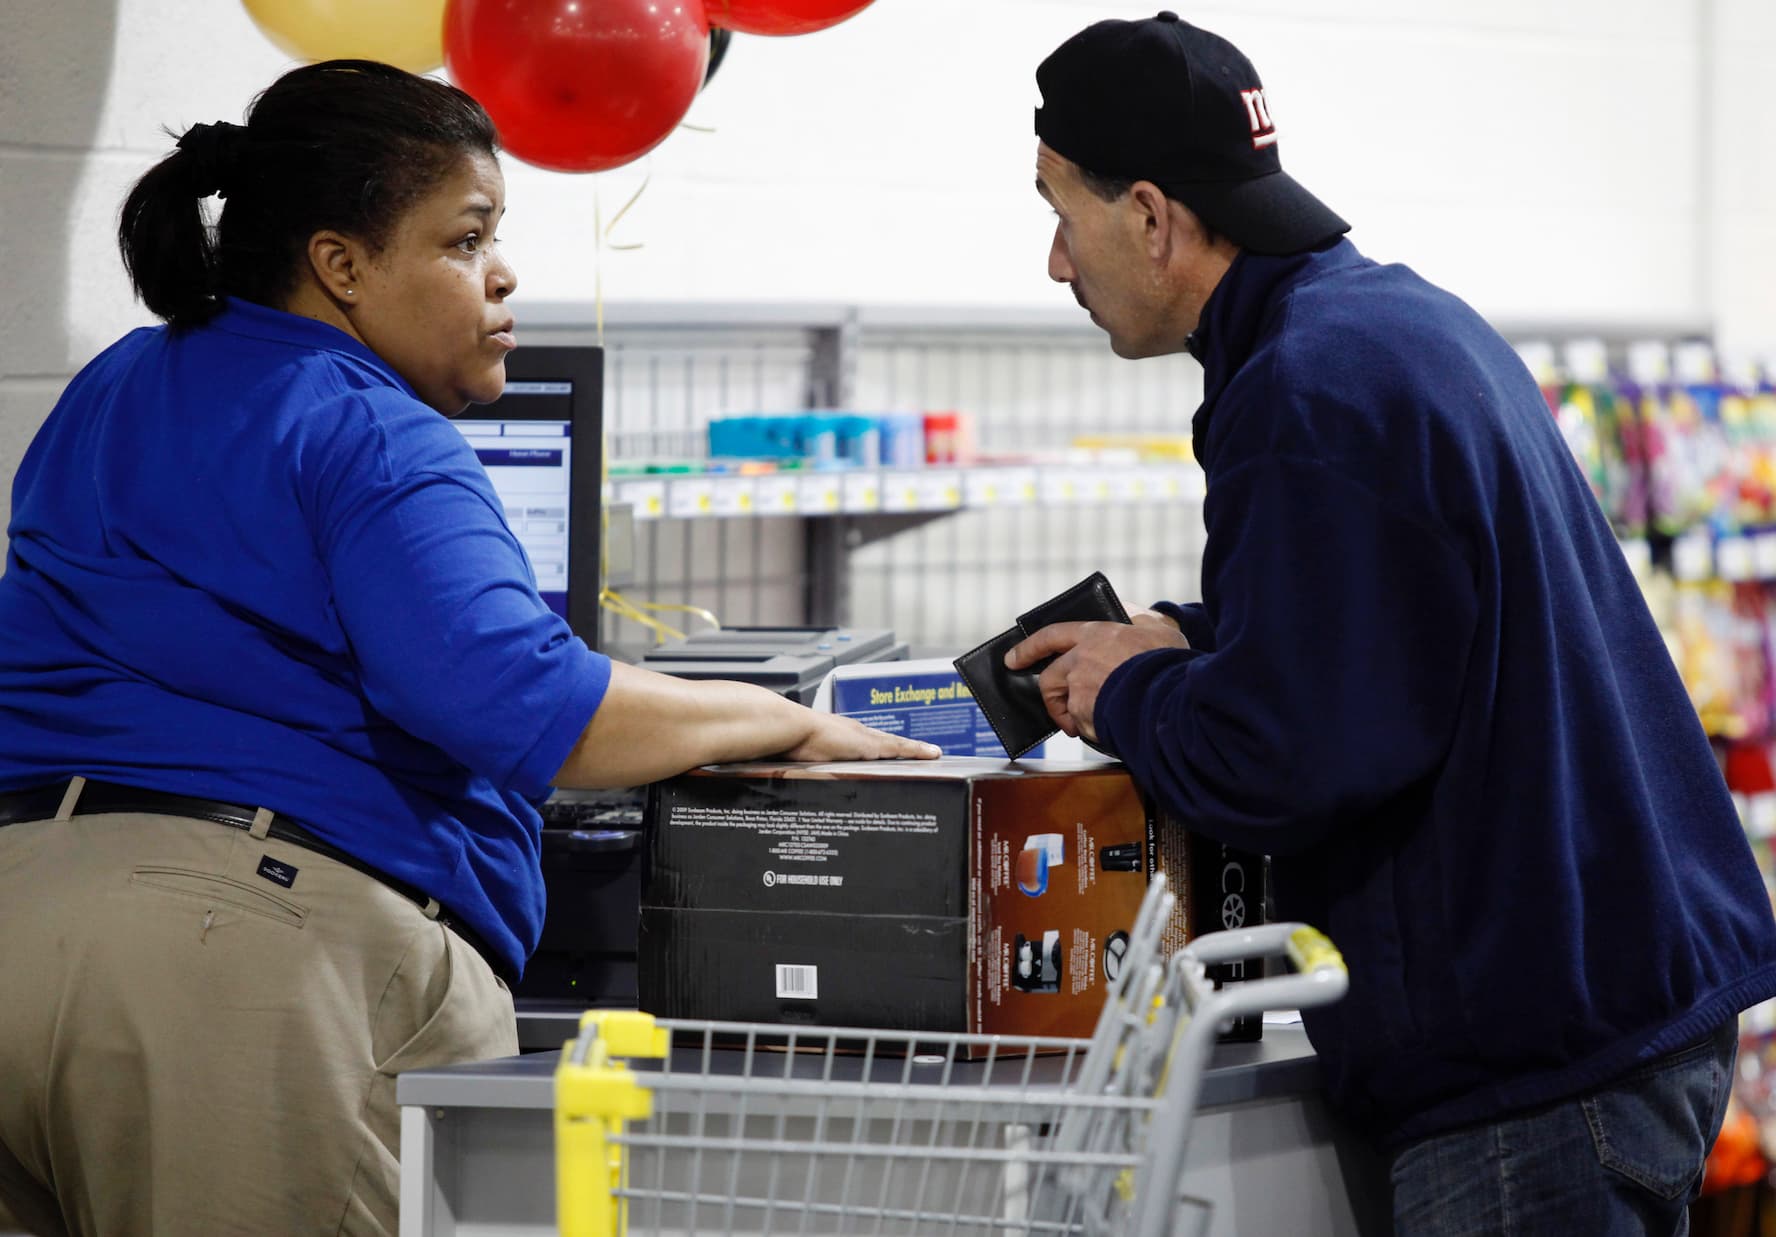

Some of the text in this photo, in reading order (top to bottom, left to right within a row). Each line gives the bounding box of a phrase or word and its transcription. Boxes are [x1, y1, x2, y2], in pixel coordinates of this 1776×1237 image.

[870, 688, 893, 705] Store
[895, 684, 936, 705] Exchange
[938, 681, 955, 700] and
[777, 874, 843, 887] FOR HOUSEHOLD USE ONLY
